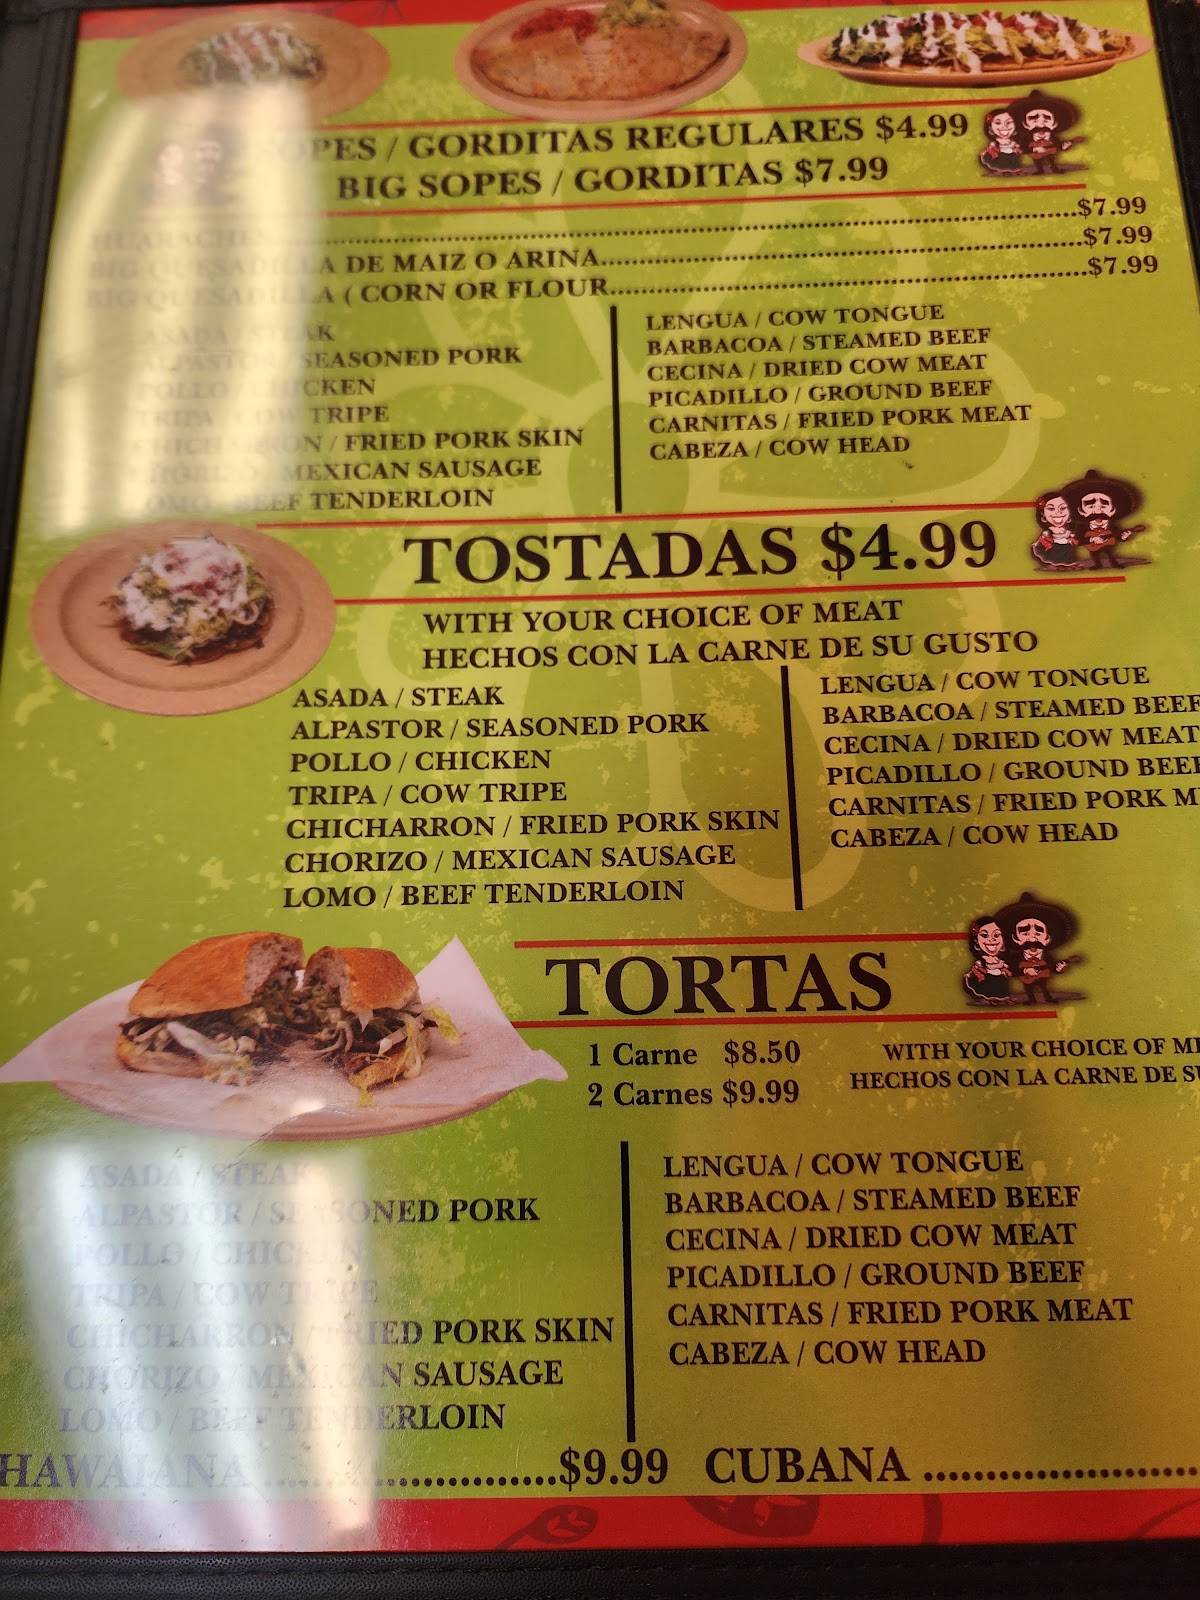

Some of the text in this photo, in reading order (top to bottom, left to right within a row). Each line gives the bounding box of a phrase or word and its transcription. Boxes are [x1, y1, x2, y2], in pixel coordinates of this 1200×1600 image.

[409, 128, 613, 158] GORDITAS
[627, 117, 863, 150] REGULARES
[876, 114, 968, 144] $4.99
[338, 157, 888, 199] BIG SOPES GORDITAS $7.99
[1078, 197, 1146, 220] $7.99
[347, 256, 382, 273] DE
[393, 253, 465, 272] MAIZ
[475, 252, 497, 269] O
[1083, 226, 1152, 248] $7.99
[361, 284, 445, 302] CORN
[455, 282, 498, 300] OR
[1088, 255, 1158, 278] $7.99
[646, 304, 944, 330] LENGUA COW TONGUE
[647, 328, 991, 355] BARBACOA STEAMED BEEF
[305, 348, 439, 368] SEASONED
[448, 346, 522, 365] PORK
[648, 354, 987, 381] CECINA DRIED COW MEAT
[649, 380, 992, 407] PICADILLO GROUND BEEF
[310, 406, 389, 423] TRIPE
[649, 405, 1032, 433] CARNITAS FRIED PORK MEAT
[346, 429, 584, 451] FRIED PORK SKIN
[650, 436, 910, 460] CABEZA COW HEAD
[288, 459, 542, 481] MEXICAN SAUSAGE
[311, 489, 493, 509] TENDERLOIN
[404, 521, 995, 584] TOSTADAS $4.99
[423, 600, 902, 634] WITH YOUR CHOICE OF MEAT
[422, 631, 1039, 669] HECHOS CON LA CARNE DE SU GUSTO
[820, 666, 1150, 694] LENGUA COW TONGUE
[292, 686, 504, 708] ASADA STEAK
[822, 695, 1200, 724] BARBACOA STEAMED BEEF
[291, 713, 710, 740] ALPASTOR SEASONED PORK
[825, 725, 1199, 754] CECINA DRIED COW MEAT
[290, 750, 552, 772] POLLO CHICKEN
[826, 763, 981, 785] PICADILLO
[1004, 759, 1128, 780] GROUND
[288, 782, 566, 805] TRIPA COW TRIPE
[829, 795, 971, 816] CARNITAS
[992, 792, 1077, 812] FRIED
[1085, 789, 1167, 809] PORK
[286, 810, 779, 839] CHICHARRON FRIED PORK SKIN
[831, 823, 1118, 848] CABEZA COW HEAD
[285, 845, 736, 873] CHORIZO MEXICAN SAUSAGE
[283, 880, 684, 908] LOMO BEEF TENDERLOIN
[546, 952, 891, 1015] TORTAS
[590, 1039, 800, 1068] 1 Carne $8.50
[882, 1043, 950, 1061] WITH
[956, 1041, 1027, 1059] YOUR
[1031, 1039, 1127, 1057] CHOICE
[1133, 1038, 1165, 1055] OF
[850, 1065, 1200, 1089] HECHOS CON LA CARNE DE S
[588, 1078, 799, 1108] 2 Carnes $9.99
[664, 1150, 1024, 1177] LENGUA COW TONGUE
[449, 1198, 540, 1222] PORK
[664, 1186, 1080, 1214] BARBACOA STEAMED BEEF
[666, 1223, 1077, 1251] CECINA DRIED COW MEAT
[667, 1261, 1085, 1288] PICADILLO GROUND BEEF
[668, 1298, 1133, 1326] CARNITAS FRIED PORK MEAT
[433, 1319, 526, 1344] PORK
[535, 1317, 614, 1343] SKIN
[669, 1340, 985, 1365] CABEZA COW HEAD
[414, 1360, 563, 1387] SAUSAGE
[560, 1446, 668, 1491] $9.99
[706, 1446, 910, 1483] CUBANA
